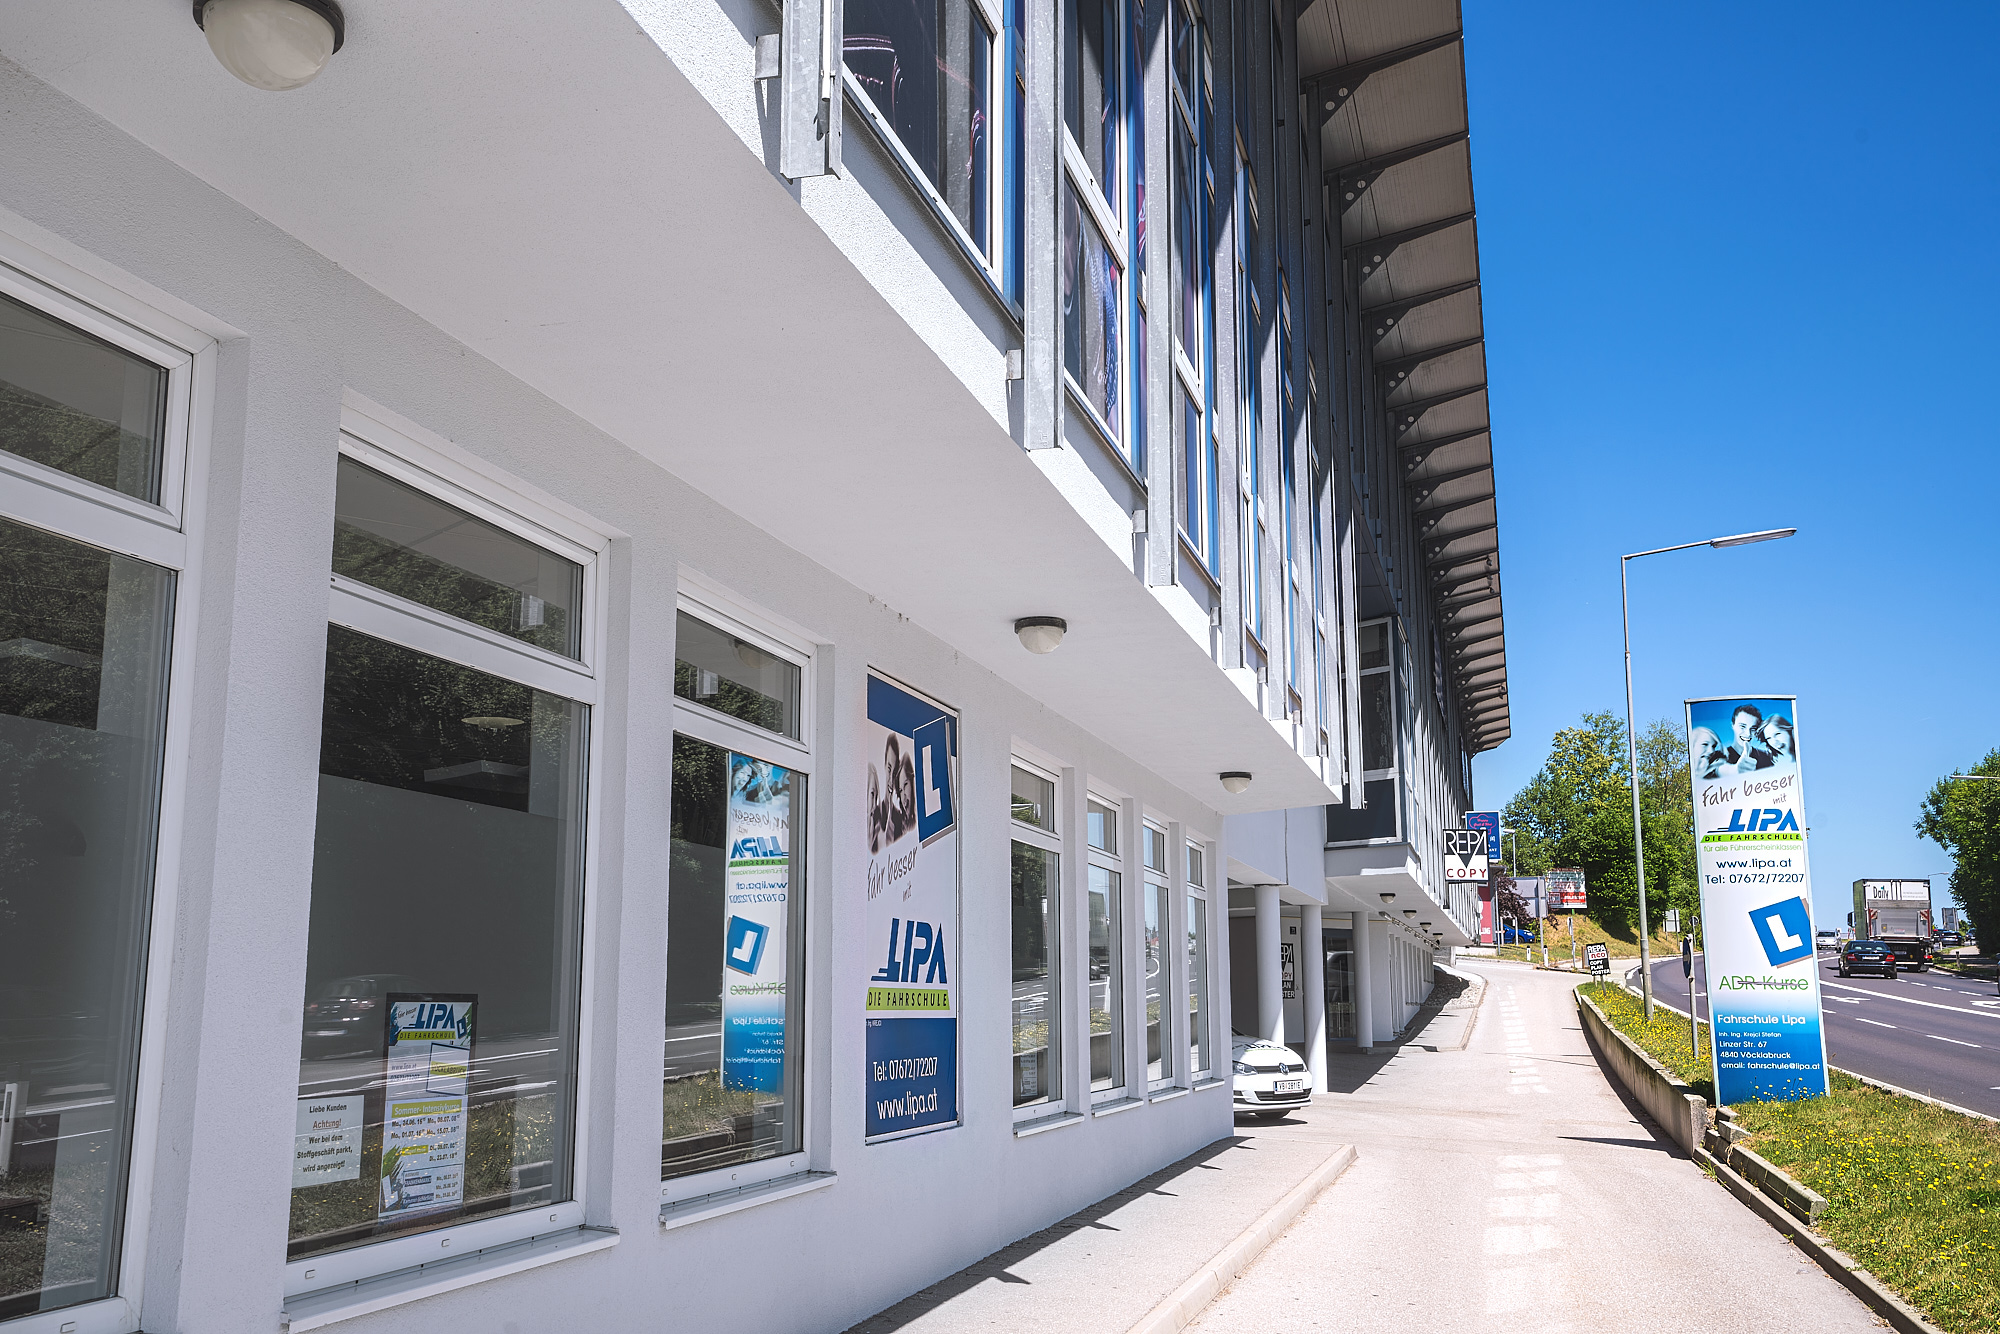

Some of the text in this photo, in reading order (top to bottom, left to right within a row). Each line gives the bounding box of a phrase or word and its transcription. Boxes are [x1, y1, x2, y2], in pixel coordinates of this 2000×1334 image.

[922, 744, 942, 818] L
[1702, 773, 1795, 807] Fahr besser
[1772, 793, 1788, 805] mit
[1707, 808, 1800, 832] LIPA
[1443, 830, 1488, 855] REPA
[1705, 833, 1800, 842] DIE FAHRSCHULE
[1703, 843, 1802, 853] für alle Führerscheinklassen
[1716, 858, 1792, 870] www.lipa.at
[867, 846, 918, 902] Fahr besser
[1446, 868, 1487, 878] COPY
[1705, 873, 1805, 885] Tel: 07672/72207
[902, 880, 912, 903] mit
[1765, 913, 1804, 953] L
[871, 918, 948, 985] LIPA
[868, 991, 948, 1007] DIE FAHRSCHULE
[403, 1003, 456, 1029] LIPA
[1717, 1014, 1806, 1026] Fahrschule Lipa
[1719, 1040, 1741, 1048] Linzer
[1743, 1040, 1756, 1048] Str.
[1740, 1051, 1791, 1059] Vöcklabruck
[873, 1056, 938, 1082] Tel: 07672/72207
[1721, 1061, 1820, 1071] email: fahrschule@lipa.at
[309, 1104, 347, 1113] Liebe Kunden
[877, 1087, 938, 1120] www.lipa.at
[394, 1106, 421, 1116] Sommer-
[313, 1118, 342, 1129] Achtung!
[309, 1136, 320, 1144] Wer
[321, 1135, 331, 1143] bei
[297, 1146, 353, 1159] Stoffgeschäft parkt,
[303, 1164, 316, 1172] wird
